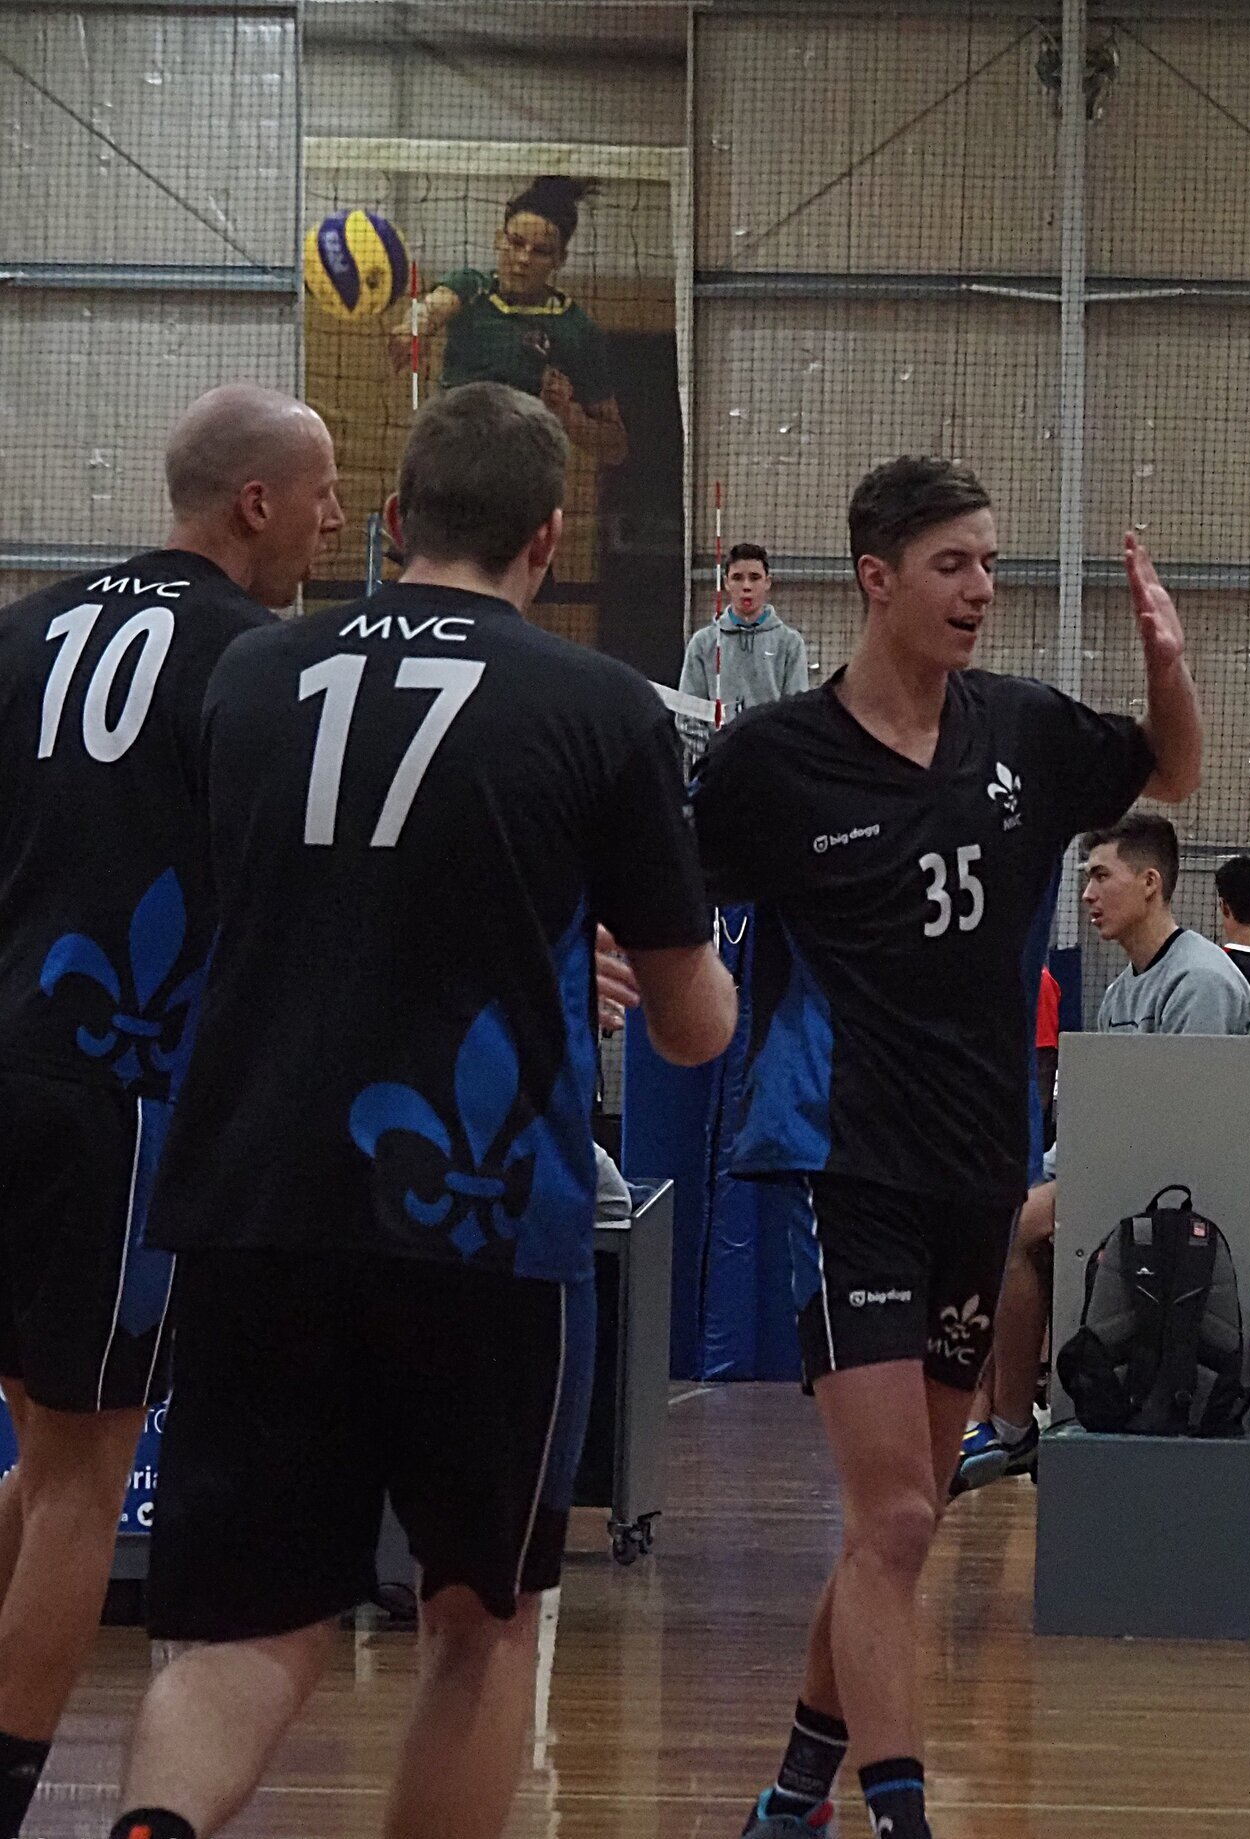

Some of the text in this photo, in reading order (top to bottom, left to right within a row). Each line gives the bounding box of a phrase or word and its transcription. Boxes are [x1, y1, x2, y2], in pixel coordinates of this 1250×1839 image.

[87, 575, 190, 598] MVC
[339, 615, 474, 641] MVC
[37, 603, 175, 762] 10
[299, 653, 486, 848] 17
[919, 844, 985, 938] 35
